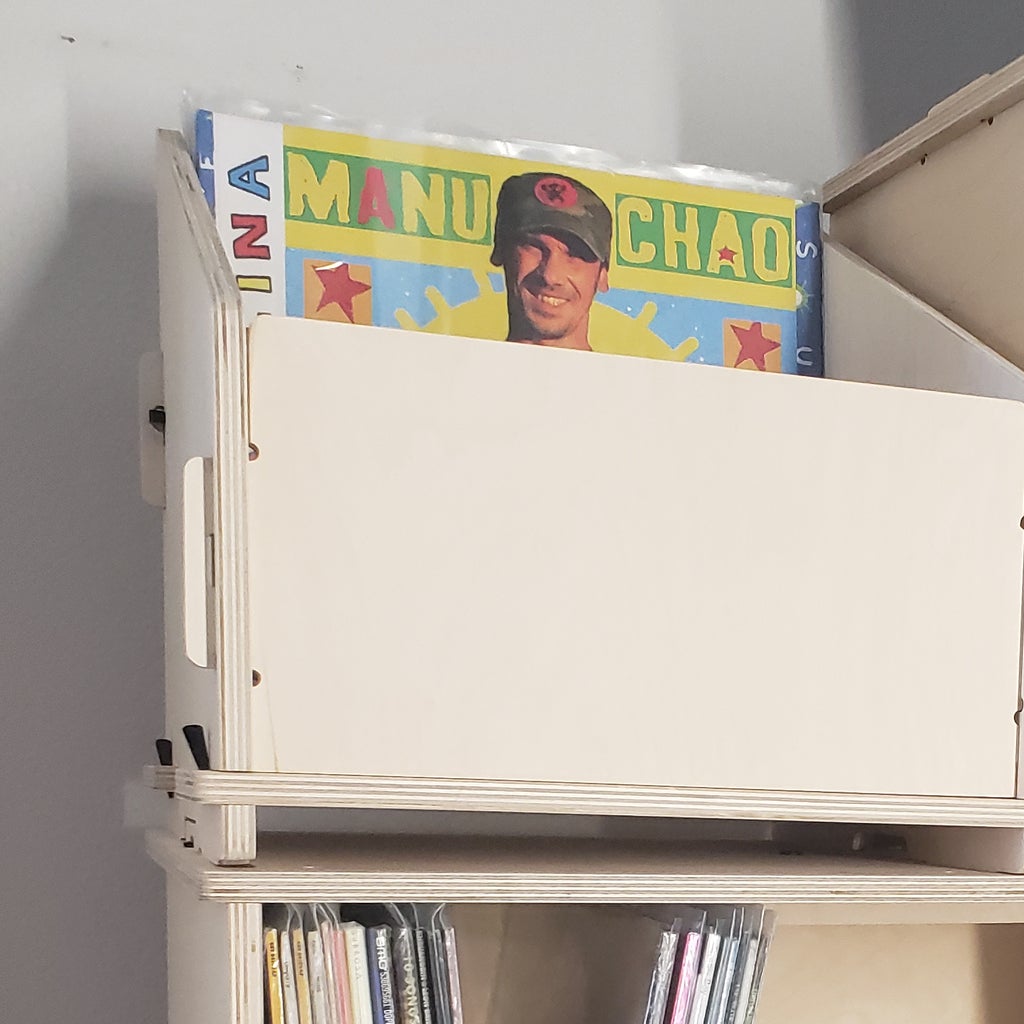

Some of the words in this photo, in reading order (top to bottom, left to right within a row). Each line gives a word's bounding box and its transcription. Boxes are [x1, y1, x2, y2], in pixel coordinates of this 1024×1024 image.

[228, 155, 272, 316] INA
[287, 152, 491, 241] MANU
[618, 195, 792, 282] CHAO
